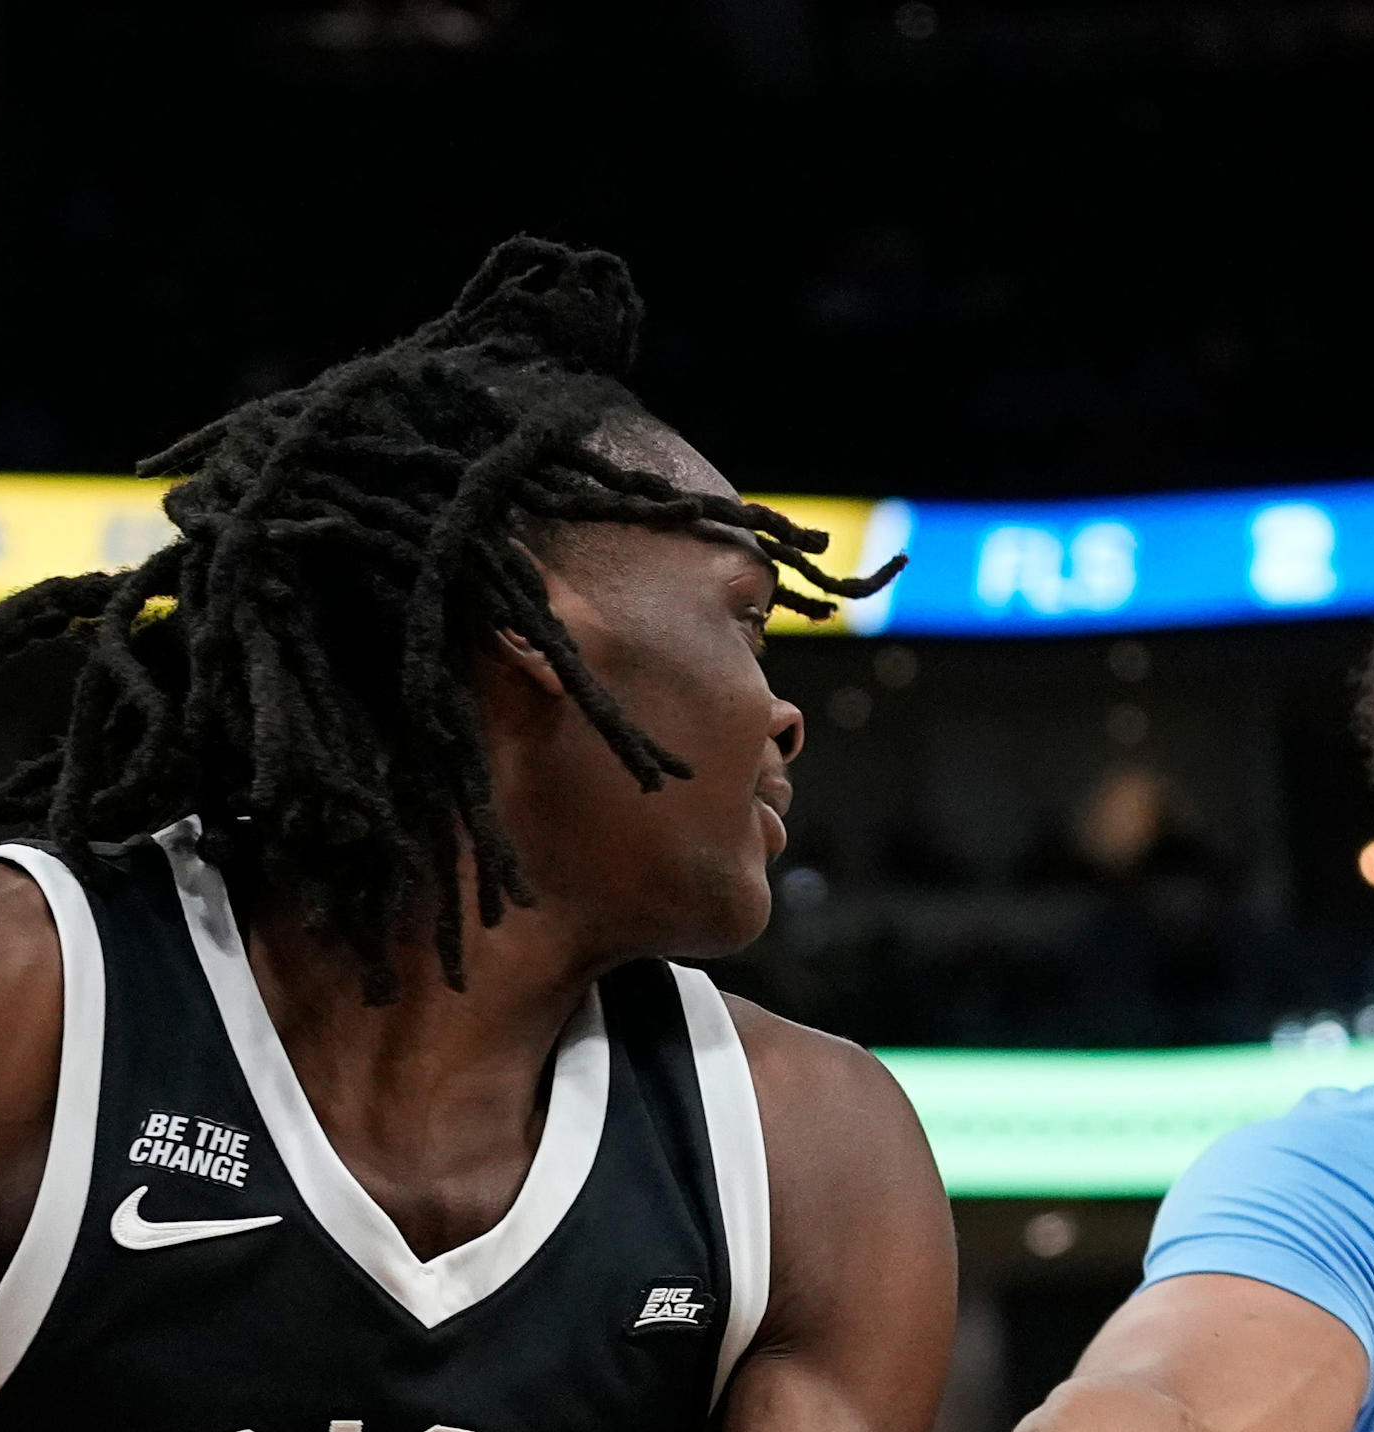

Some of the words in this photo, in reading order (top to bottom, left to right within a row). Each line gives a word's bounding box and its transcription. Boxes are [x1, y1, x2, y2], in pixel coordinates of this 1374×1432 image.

[144, 1113, 189, 1142] BE
[195, 1121, 250, 1159] THE
[129, 1137, 250, 1188] CHANGE
[640, 1303, 705, 1319] EAST
[647, 1288, 693, 1303] BIG
